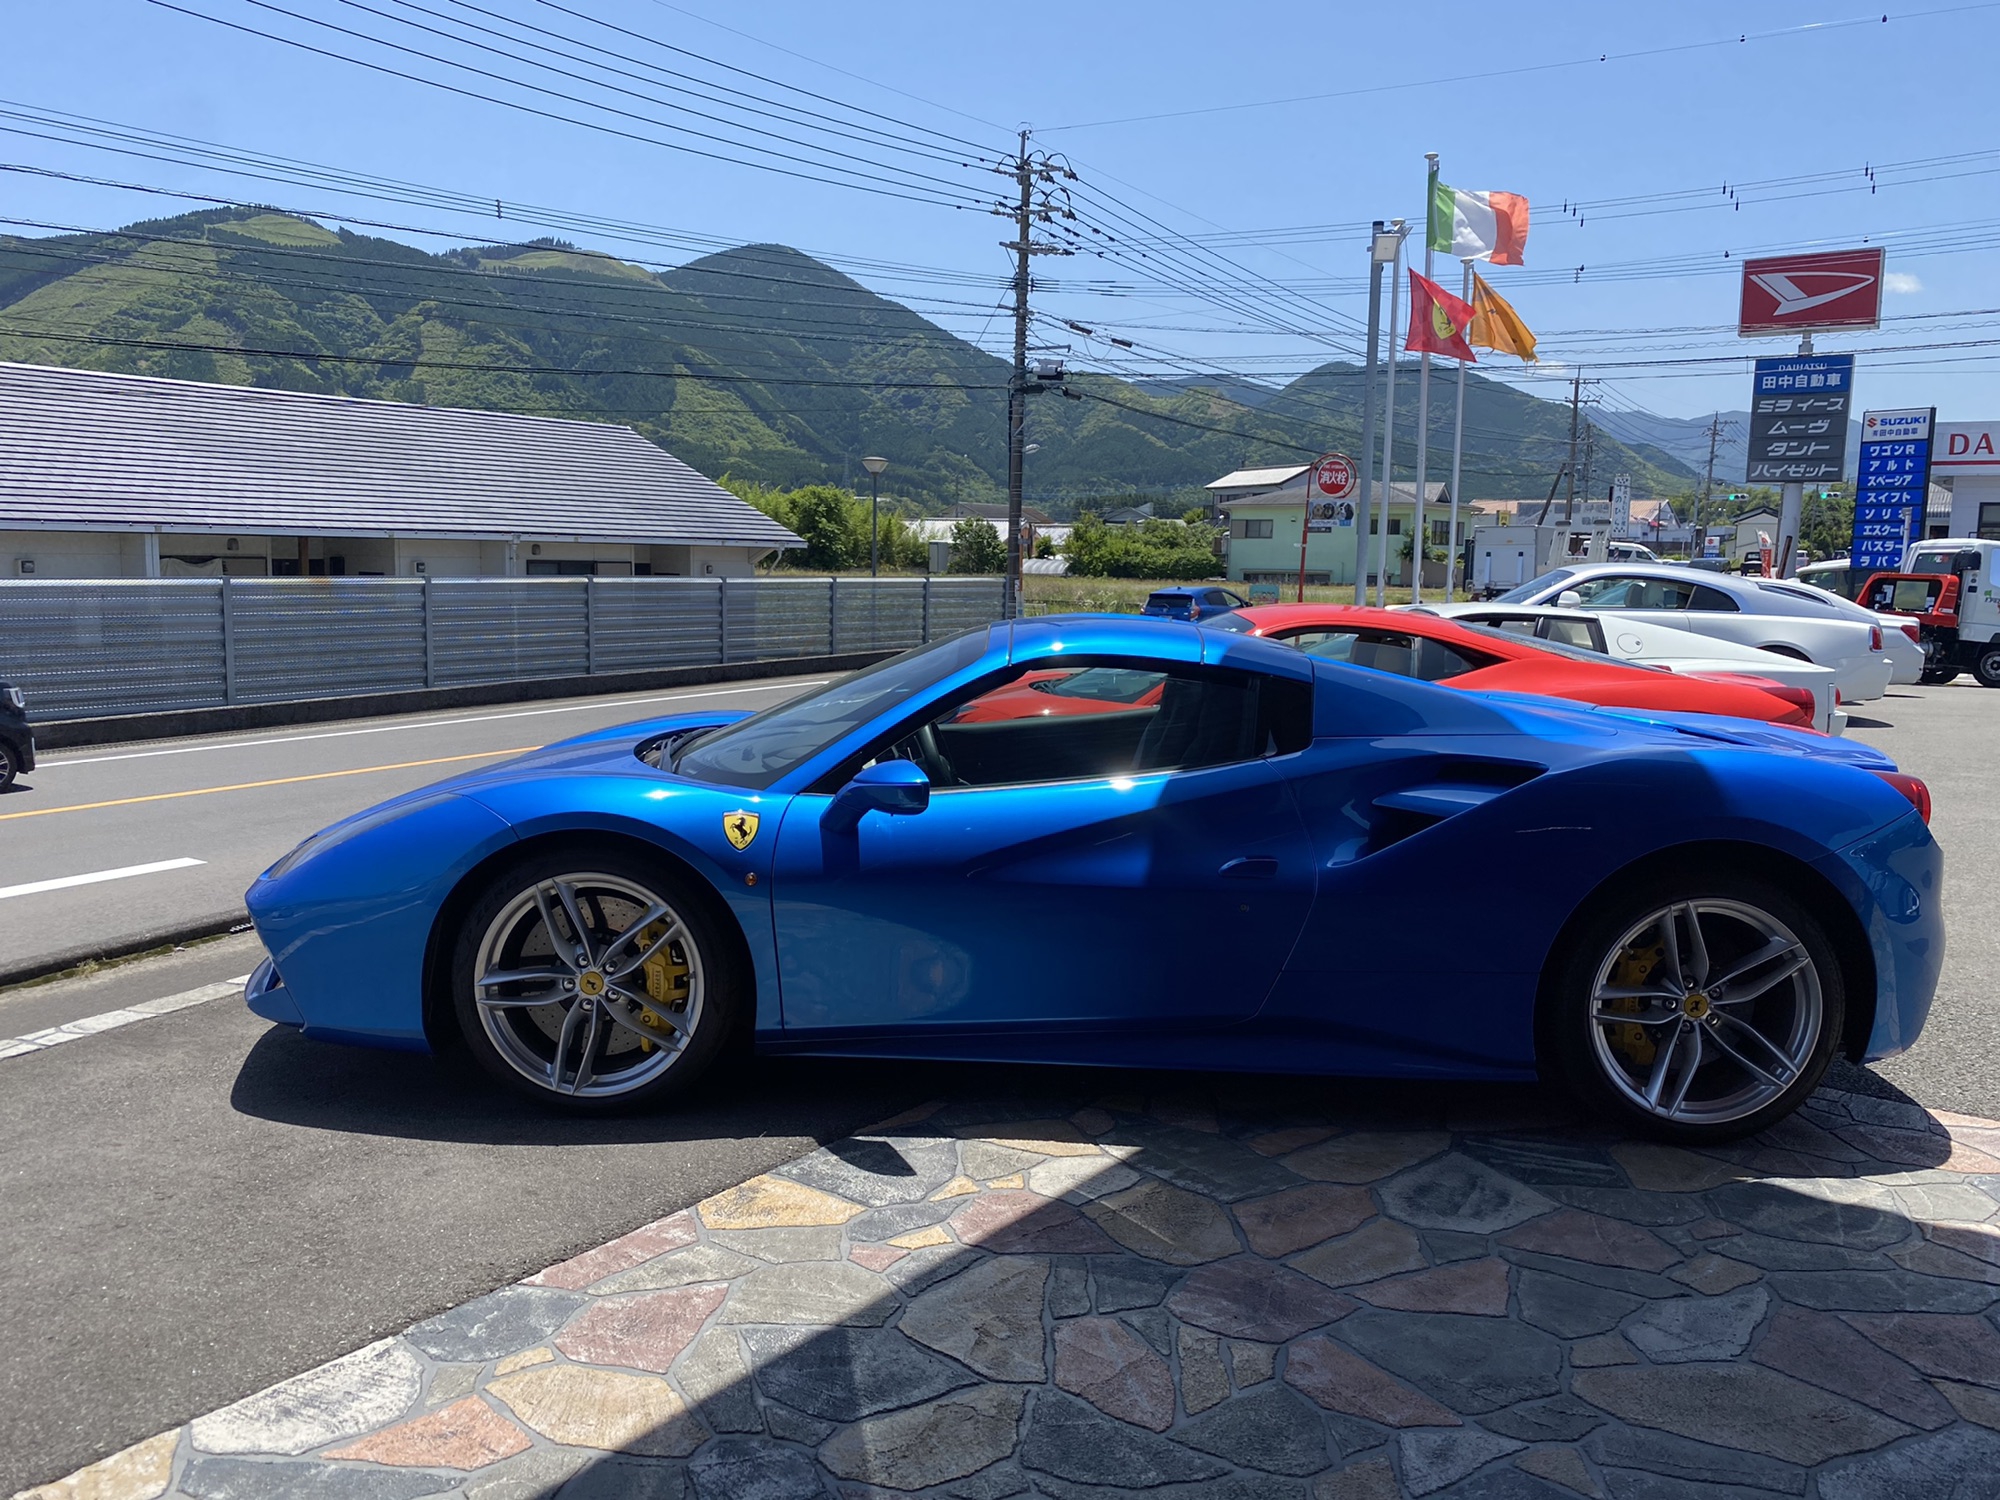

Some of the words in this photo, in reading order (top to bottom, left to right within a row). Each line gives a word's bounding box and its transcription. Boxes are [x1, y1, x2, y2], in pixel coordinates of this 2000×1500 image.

[1779, 362, 1828, 371] DAIHATSU
[1762, 373, 1841, 389] 田中自動車
[1767, 419, 1831, 435] ムーヴ
[1880, 416, 1927, 426] SUZUKI
[1766, 442, 1830, 457] タント
[1870, 444, 1915, 457] ワゴンR
[1948, 432, 1995, 456] DA
[1750, 463, 1839, 477] ハイゼット
[1869, 459, 1914, 471] アルト
[1320, 470, 1347, 485] 消火栓
[1867, 475, 1913, 487] スペーシア
[1866, 492, 1911, 503] スイフト
